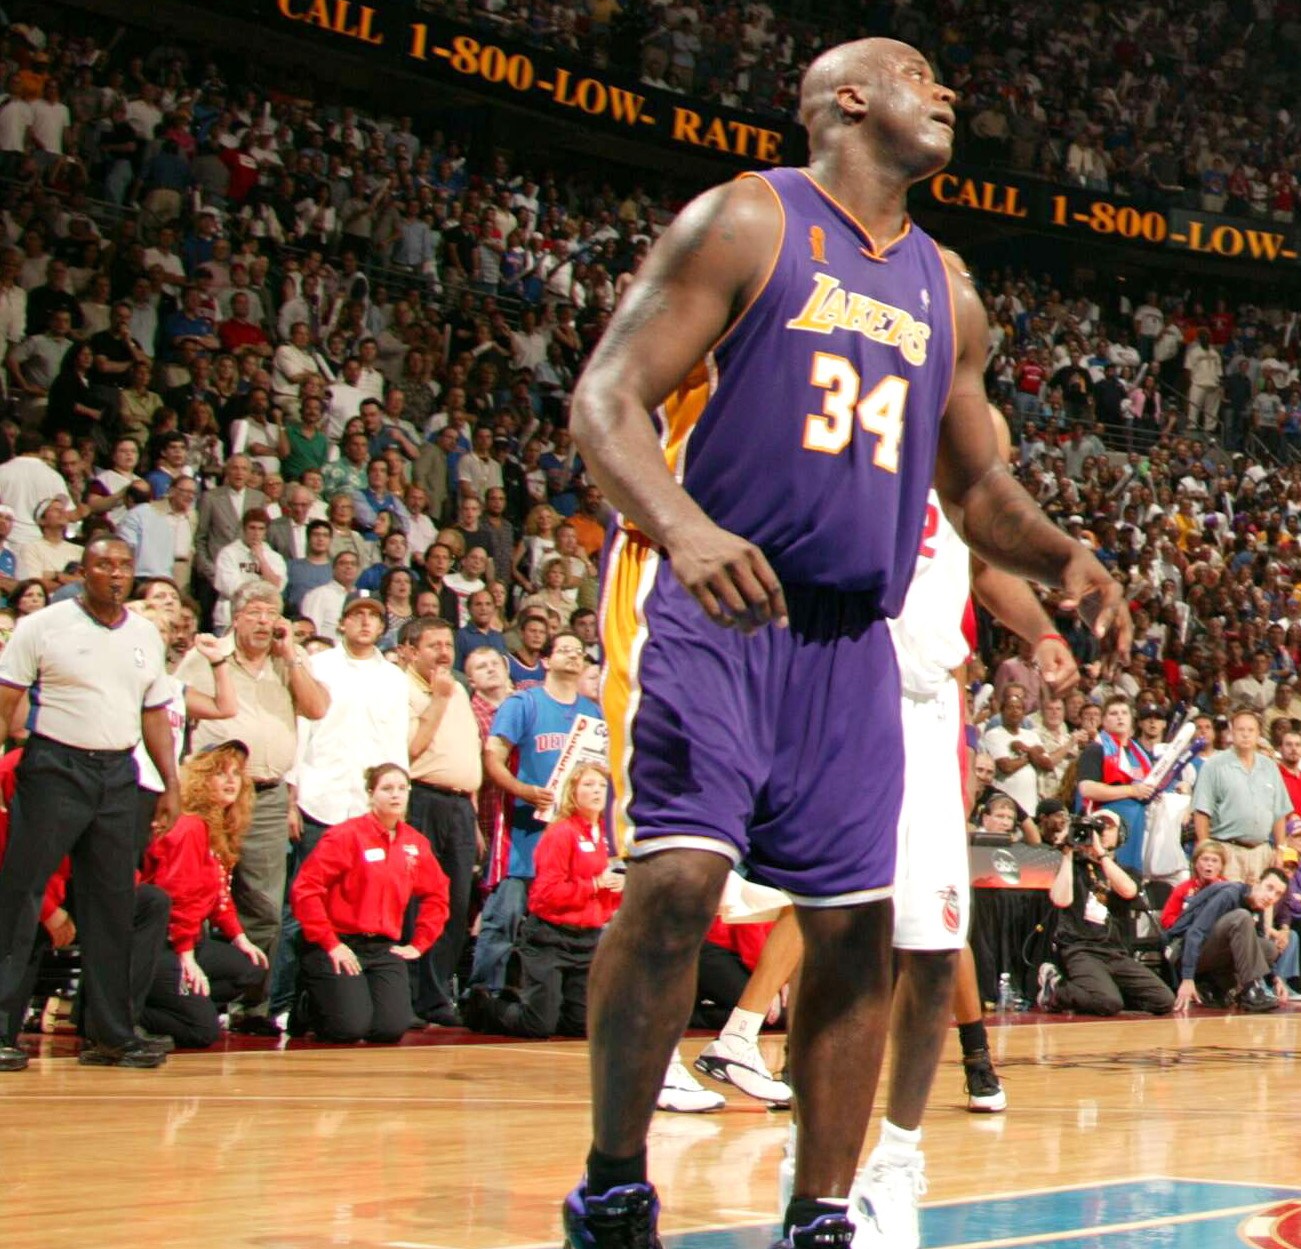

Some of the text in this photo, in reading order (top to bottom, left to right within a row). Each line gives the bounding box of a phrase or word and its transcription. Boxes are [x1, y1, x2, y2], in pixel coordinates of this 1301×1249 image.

[673, 106, 784, 164] RATE
[930, 172, 1028, 219] CALL
[786, 271, 932, 368] LAKERS
[801, 350, 910, 475] 34
